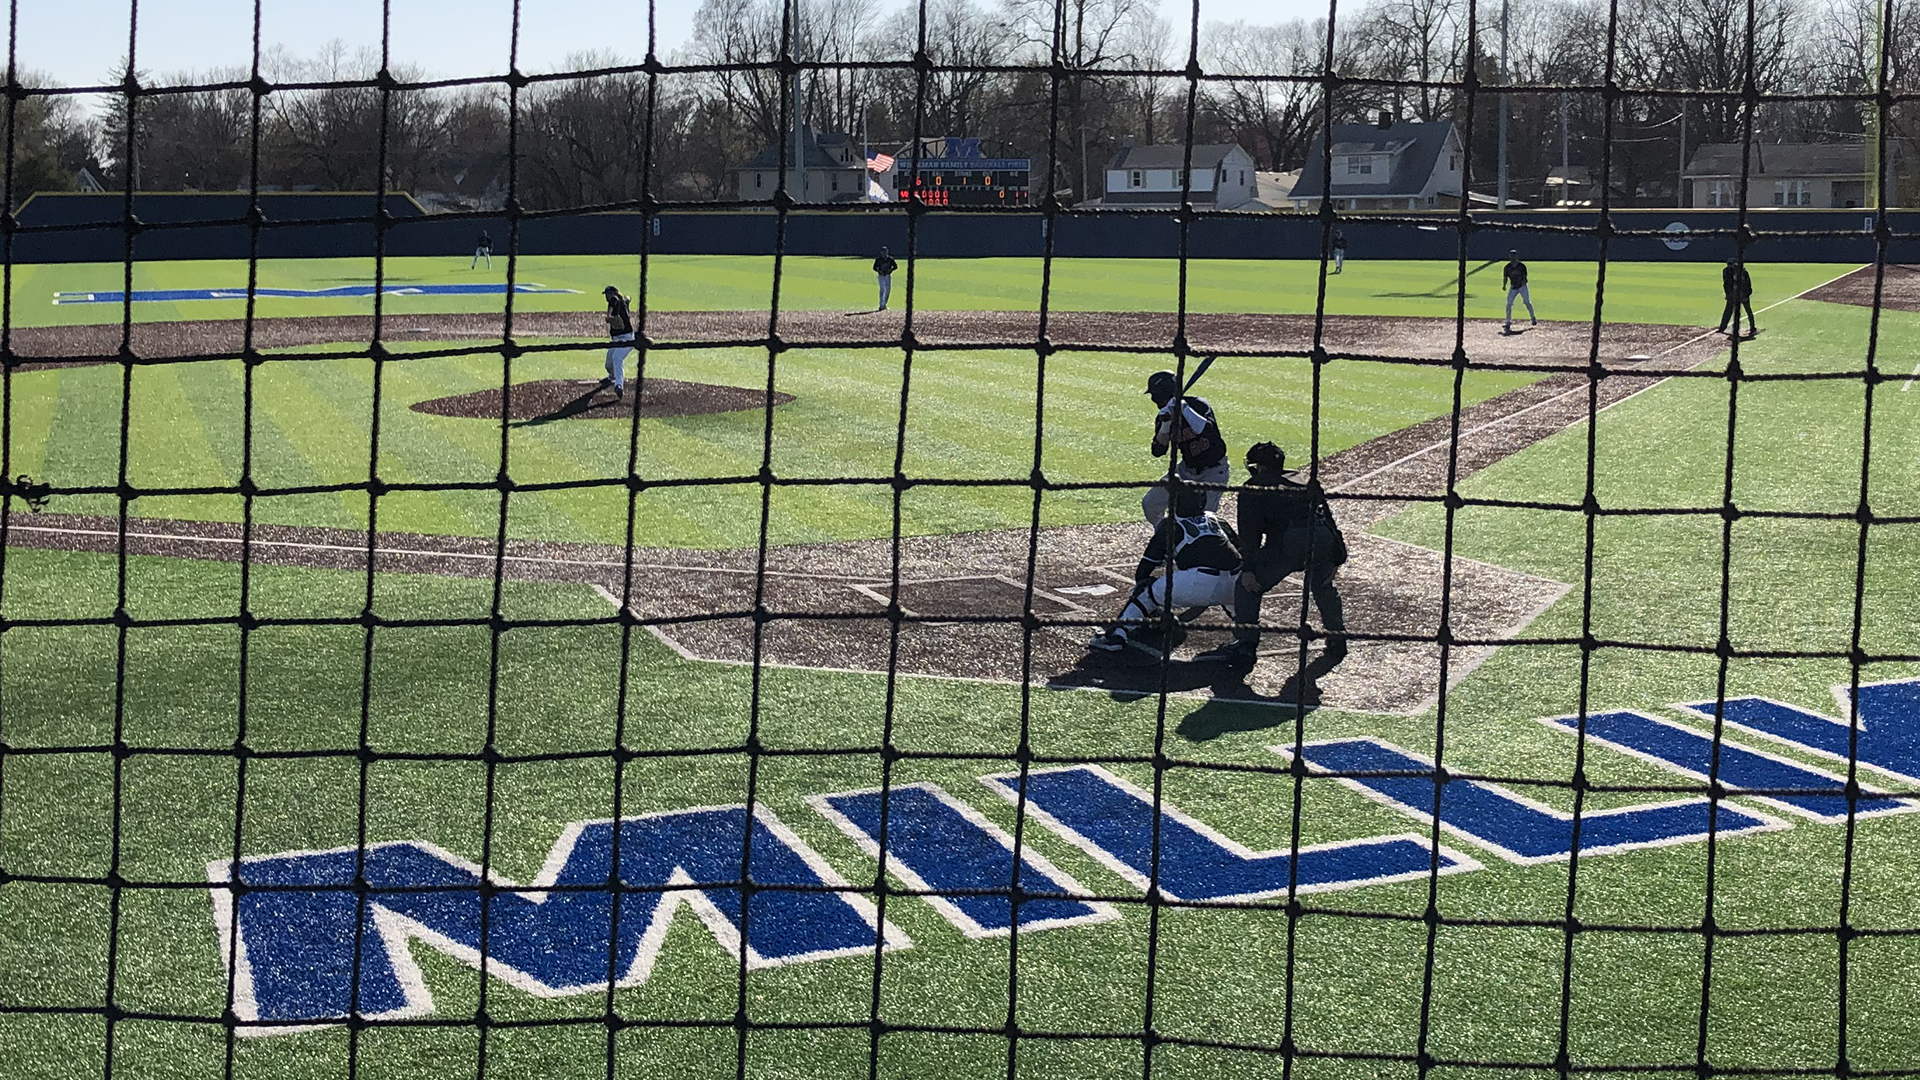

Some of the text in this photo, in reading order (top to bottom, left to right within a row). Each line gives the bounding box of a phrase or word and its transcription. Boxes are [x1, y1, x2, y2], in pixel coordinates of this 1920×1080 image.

[946, 137, 980, 158] M
[935, 176, 942, 186] 0
[984, 176, 991, 186] 0
